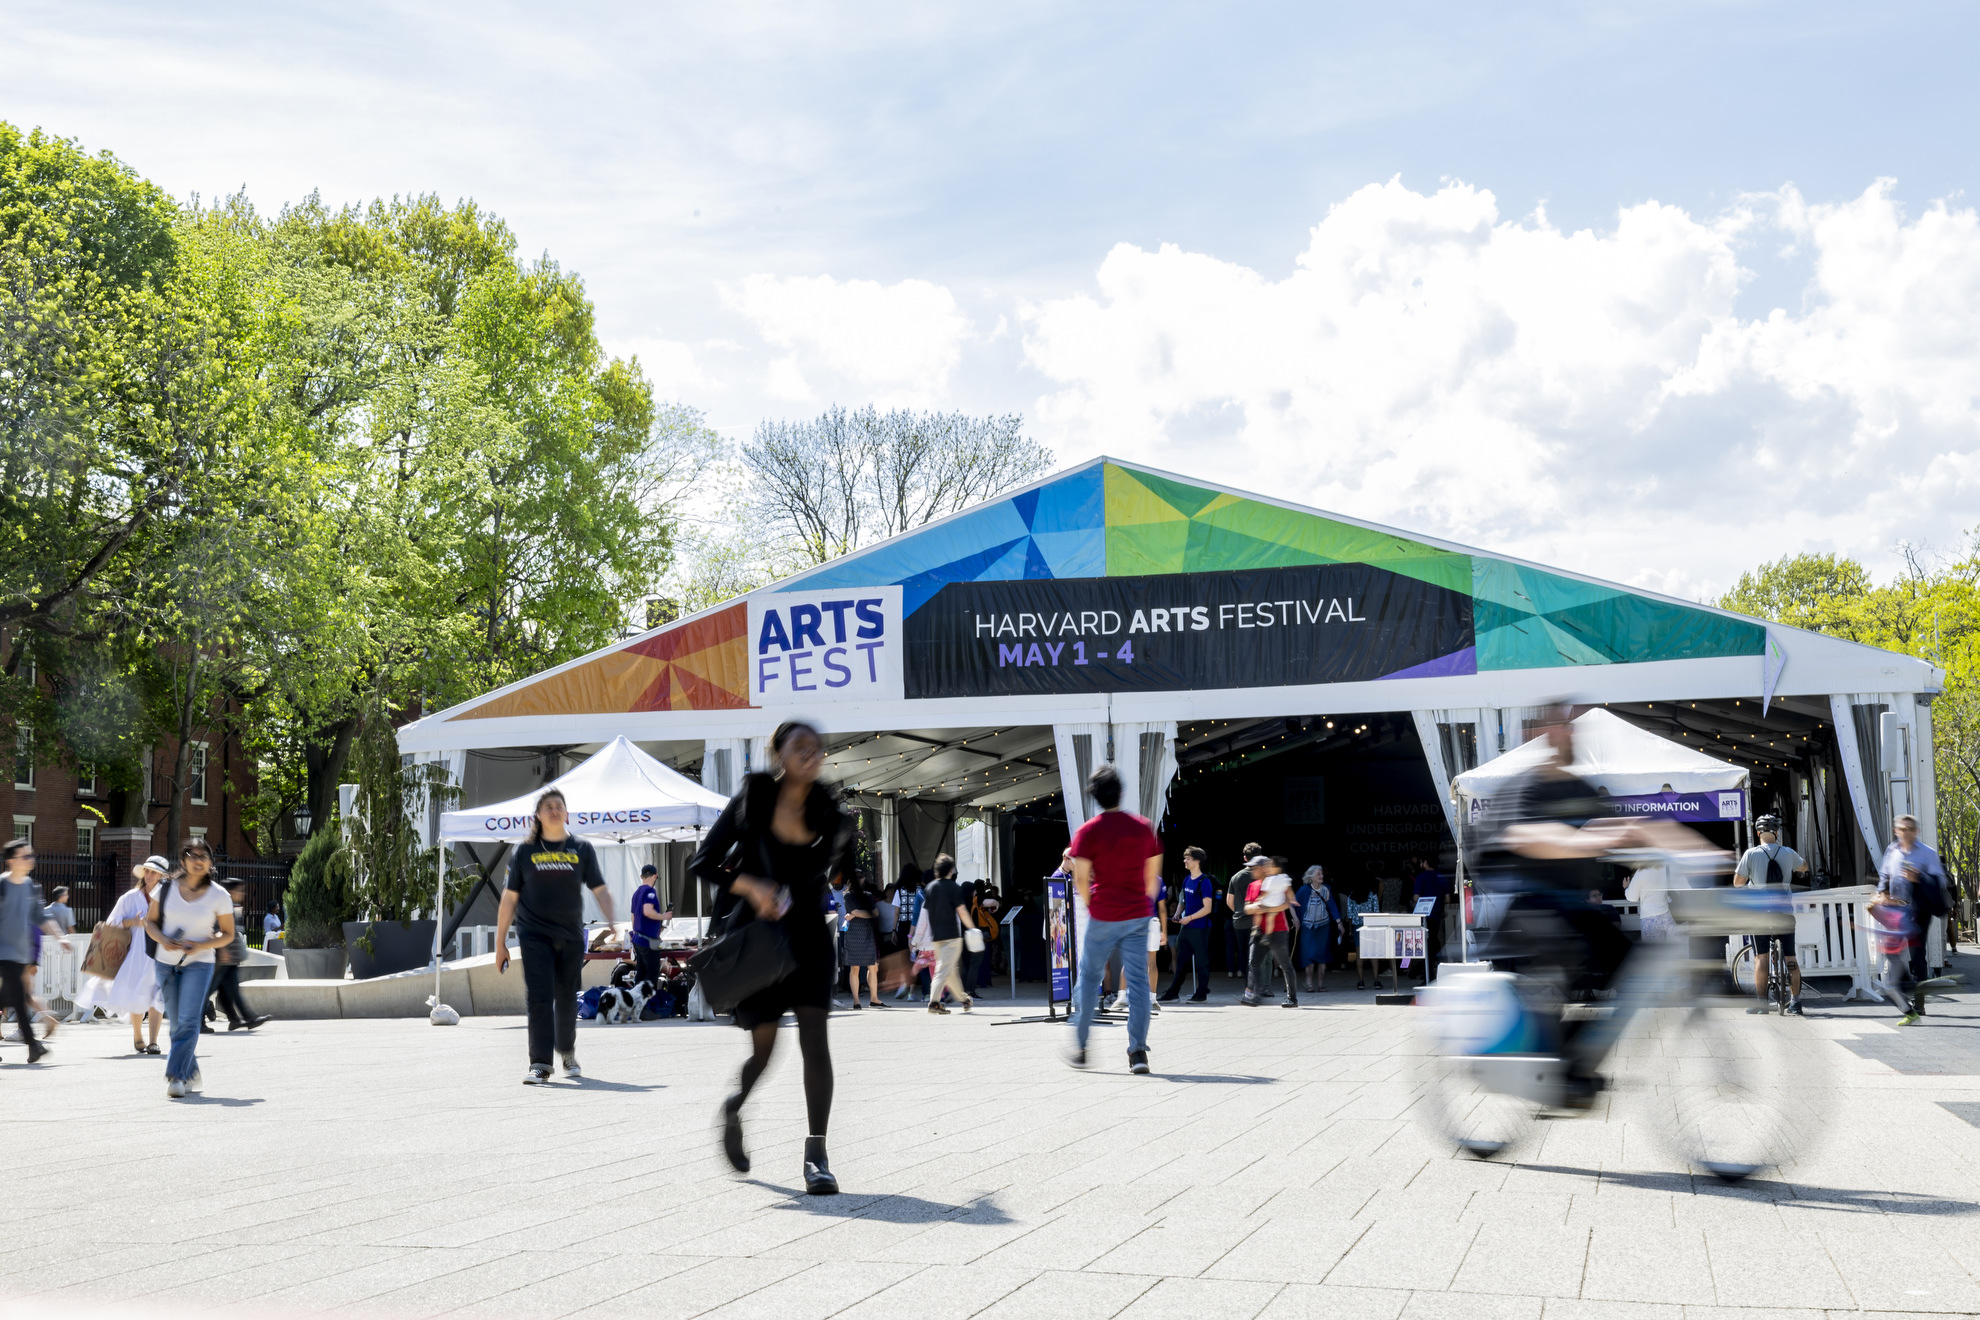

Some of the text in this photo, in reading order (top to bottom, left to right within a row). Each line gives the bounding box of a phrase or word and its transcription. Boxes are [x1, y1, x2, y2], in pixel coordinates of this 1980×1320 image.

[758, 598, 884, 655] ARTS
[976, 597, 1366, 638] HARVARD ARTS FESTIVAL
[758, 641, 884, 693] FEST
[999, 642, 1065, 667] MAY
[1073, 641, 1089, 665] 1
[1116, 640, 1134, 664] 4
[577, 809, 652, 825] SPACES
[1374, 804, 1440, 816] HARVARD
[1624, 802, 1700, 813] INFORMATION
